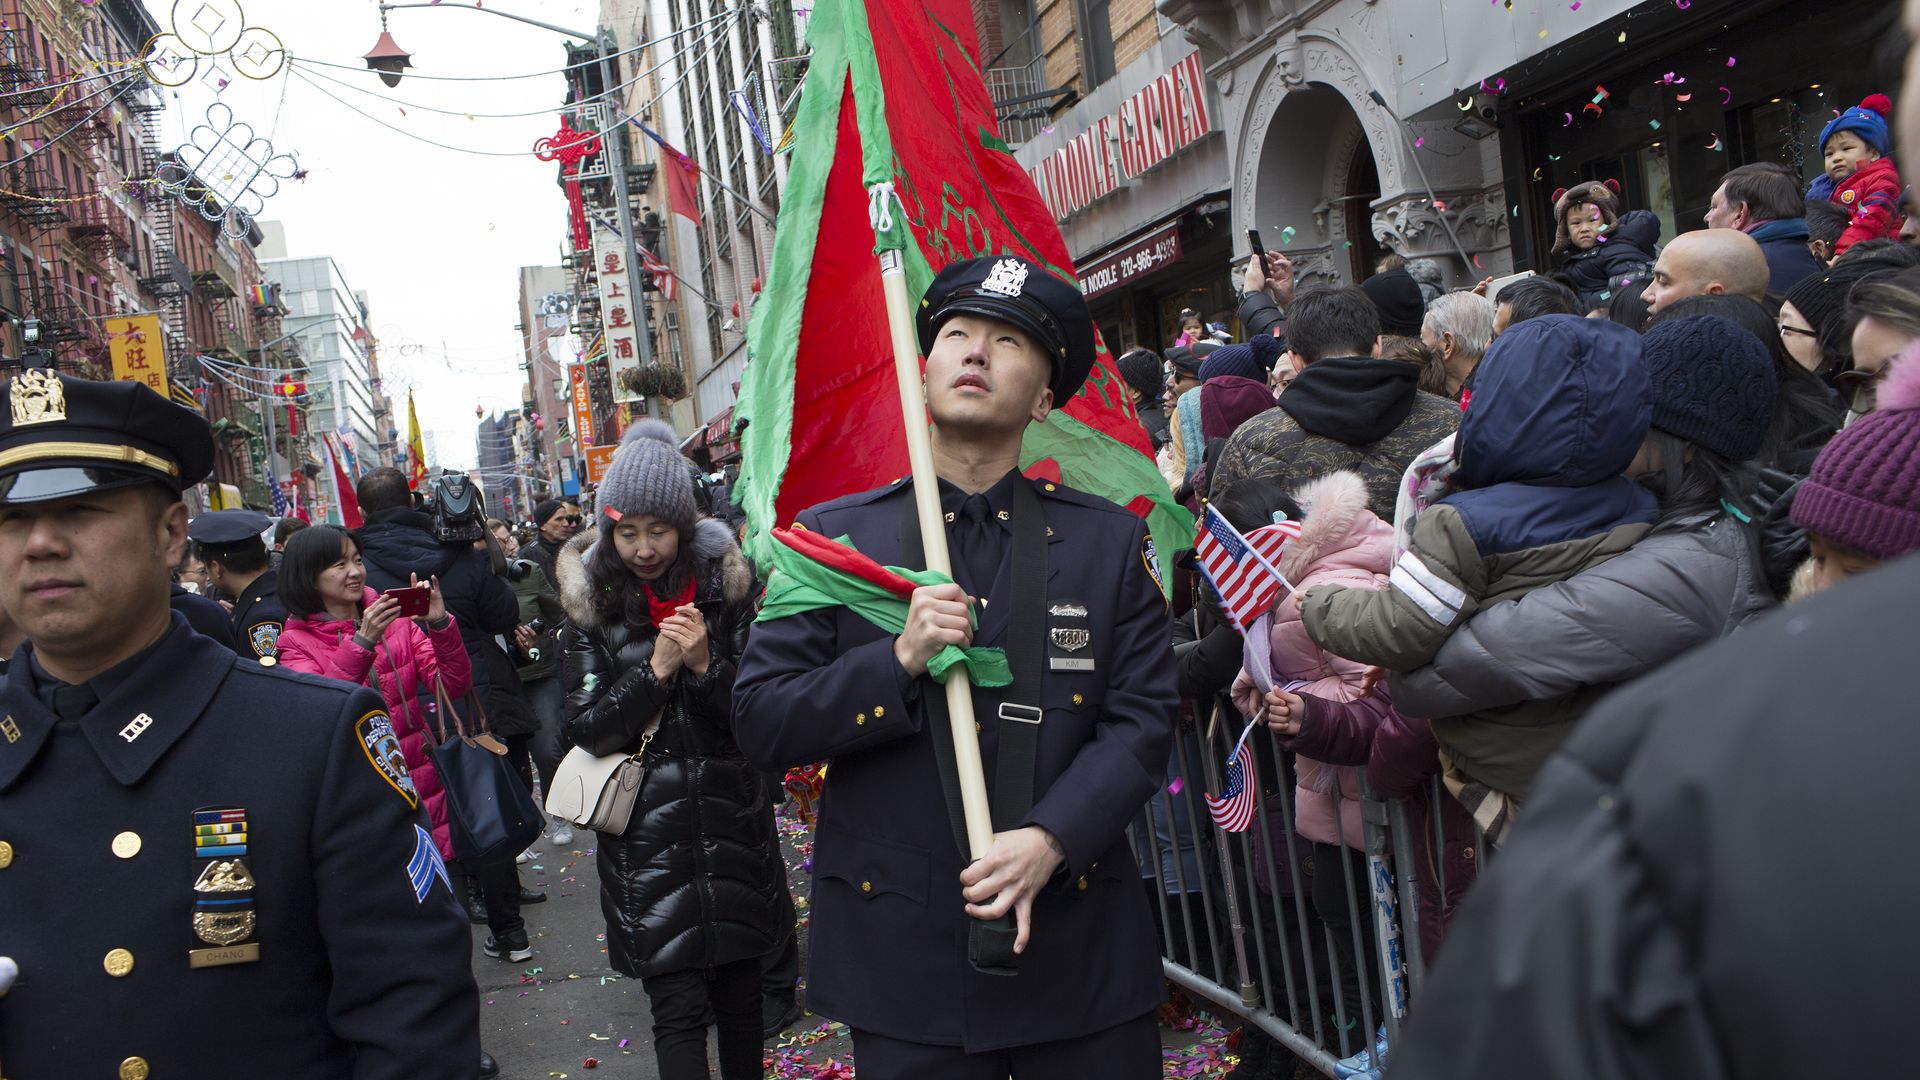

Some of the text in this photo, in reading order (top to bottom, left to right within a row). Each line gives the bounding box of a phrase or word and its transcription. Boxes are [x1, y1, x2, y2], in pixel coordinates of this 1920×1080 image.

[1118, 50, 1209, 181] GARDEN
[1088, 265, 1118, 293] NOODLE
[602, 251, 634, 378] 皇上皇酒
[1065, 660, 1079, 668] KIM
[375, 756, 395, 777] CITY
[206, 950, 245, 962] CHANG
